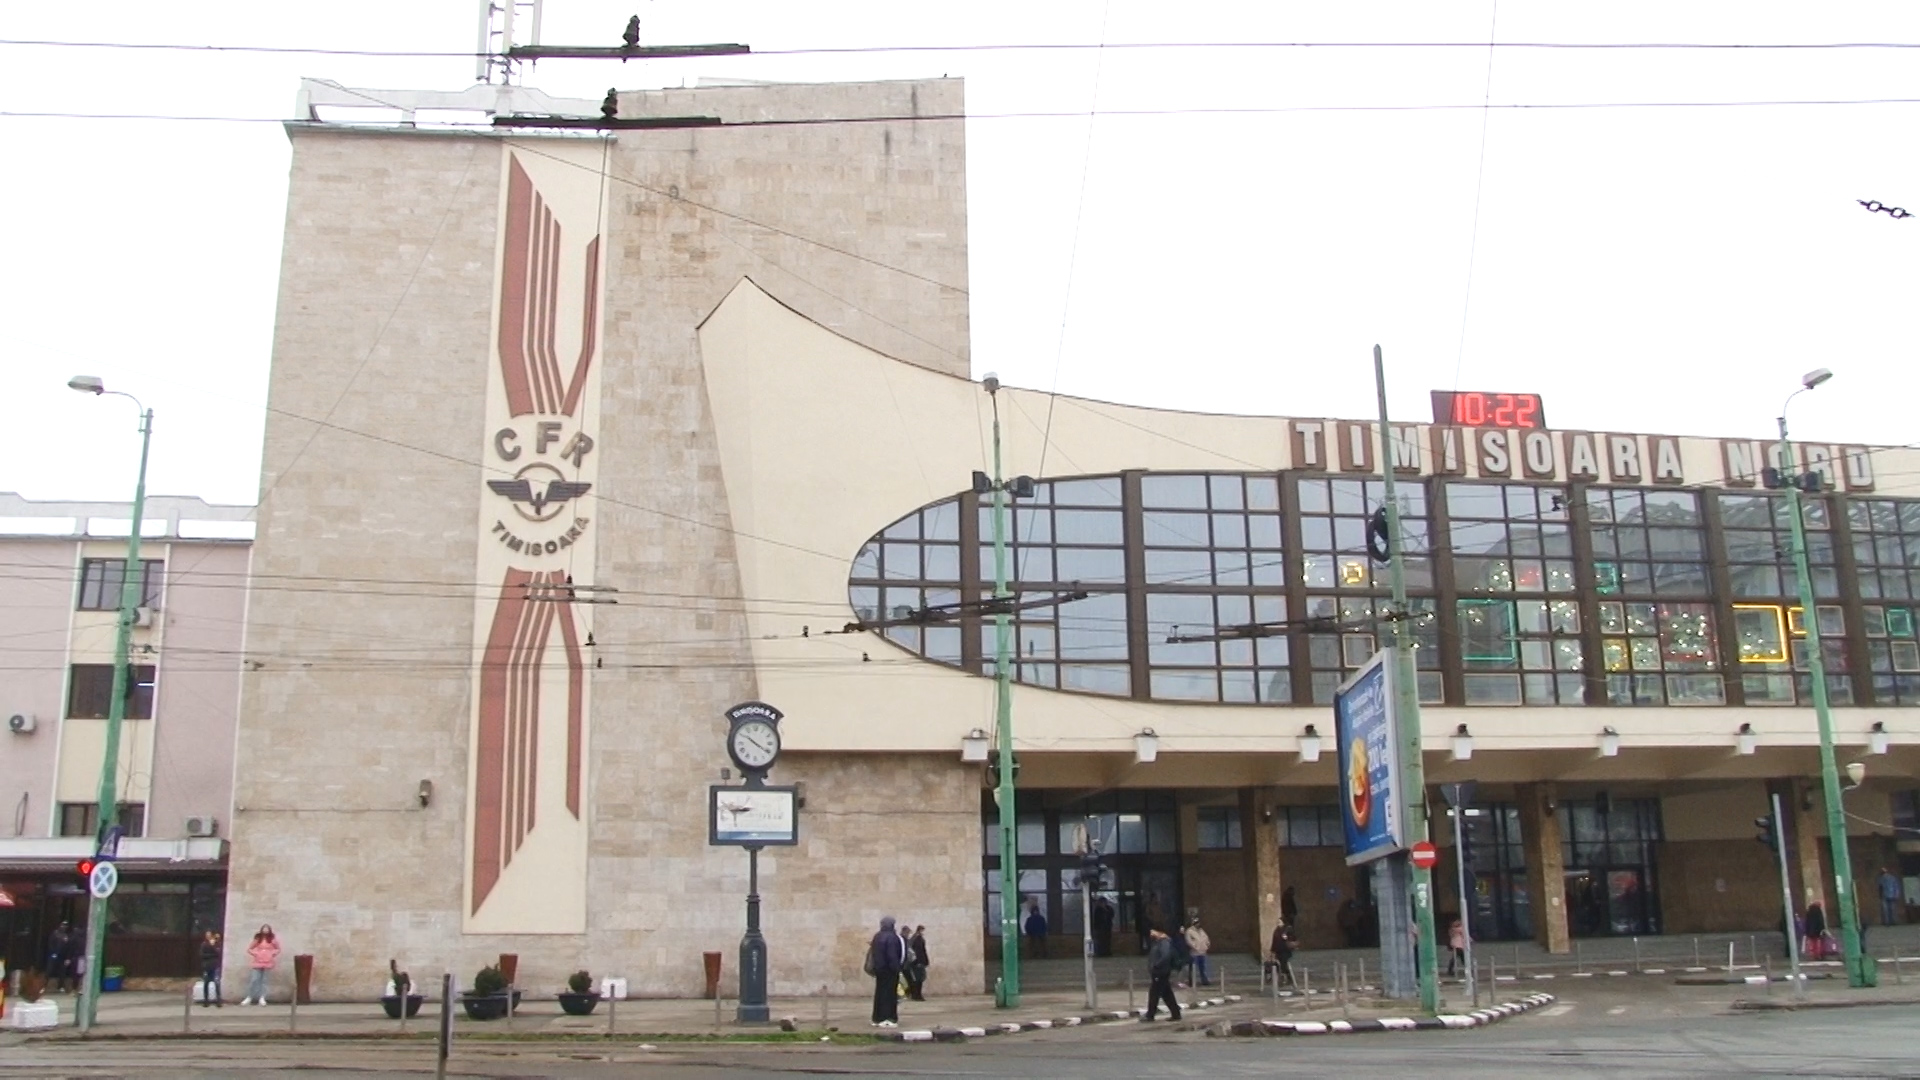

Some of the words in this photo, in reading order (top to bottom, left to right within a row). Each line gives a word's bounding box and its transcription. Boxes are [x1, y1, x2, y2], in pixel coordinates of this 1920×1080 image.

[1456, 392, 1538, 428] 10:22
[494, 421, 594, 468] CFR
[1295, 422, 1684, 480] TIMISOARA
[492, 516, 590, 556] TIMISOARA
